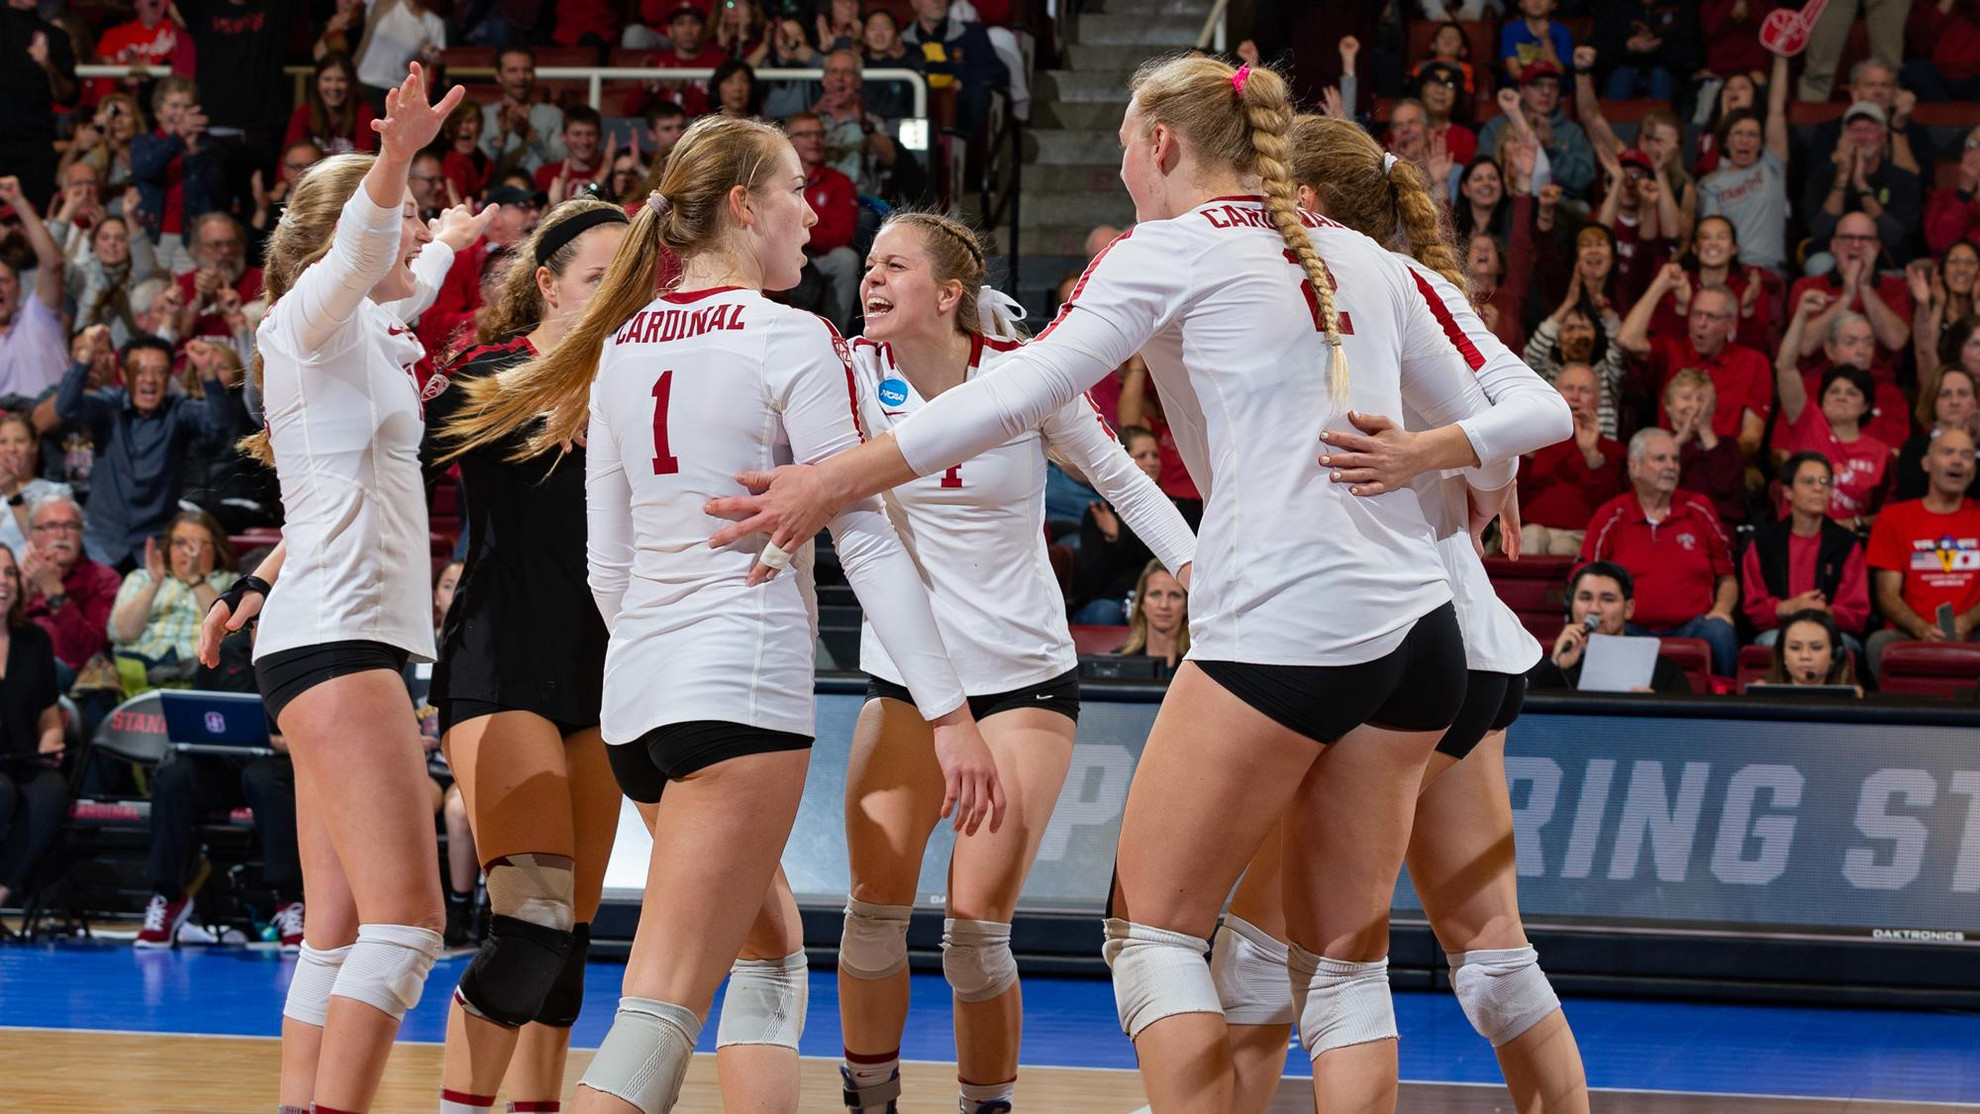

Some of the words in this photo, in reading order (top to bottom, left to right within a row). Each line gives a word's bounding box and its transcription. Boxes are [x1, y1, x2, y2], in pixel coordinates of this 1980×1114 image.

[880, 389, 905, 402] NCAA
[651, 370, 679, 475] 1
[1872, 928, 1965, 941] DAKTRONICS
